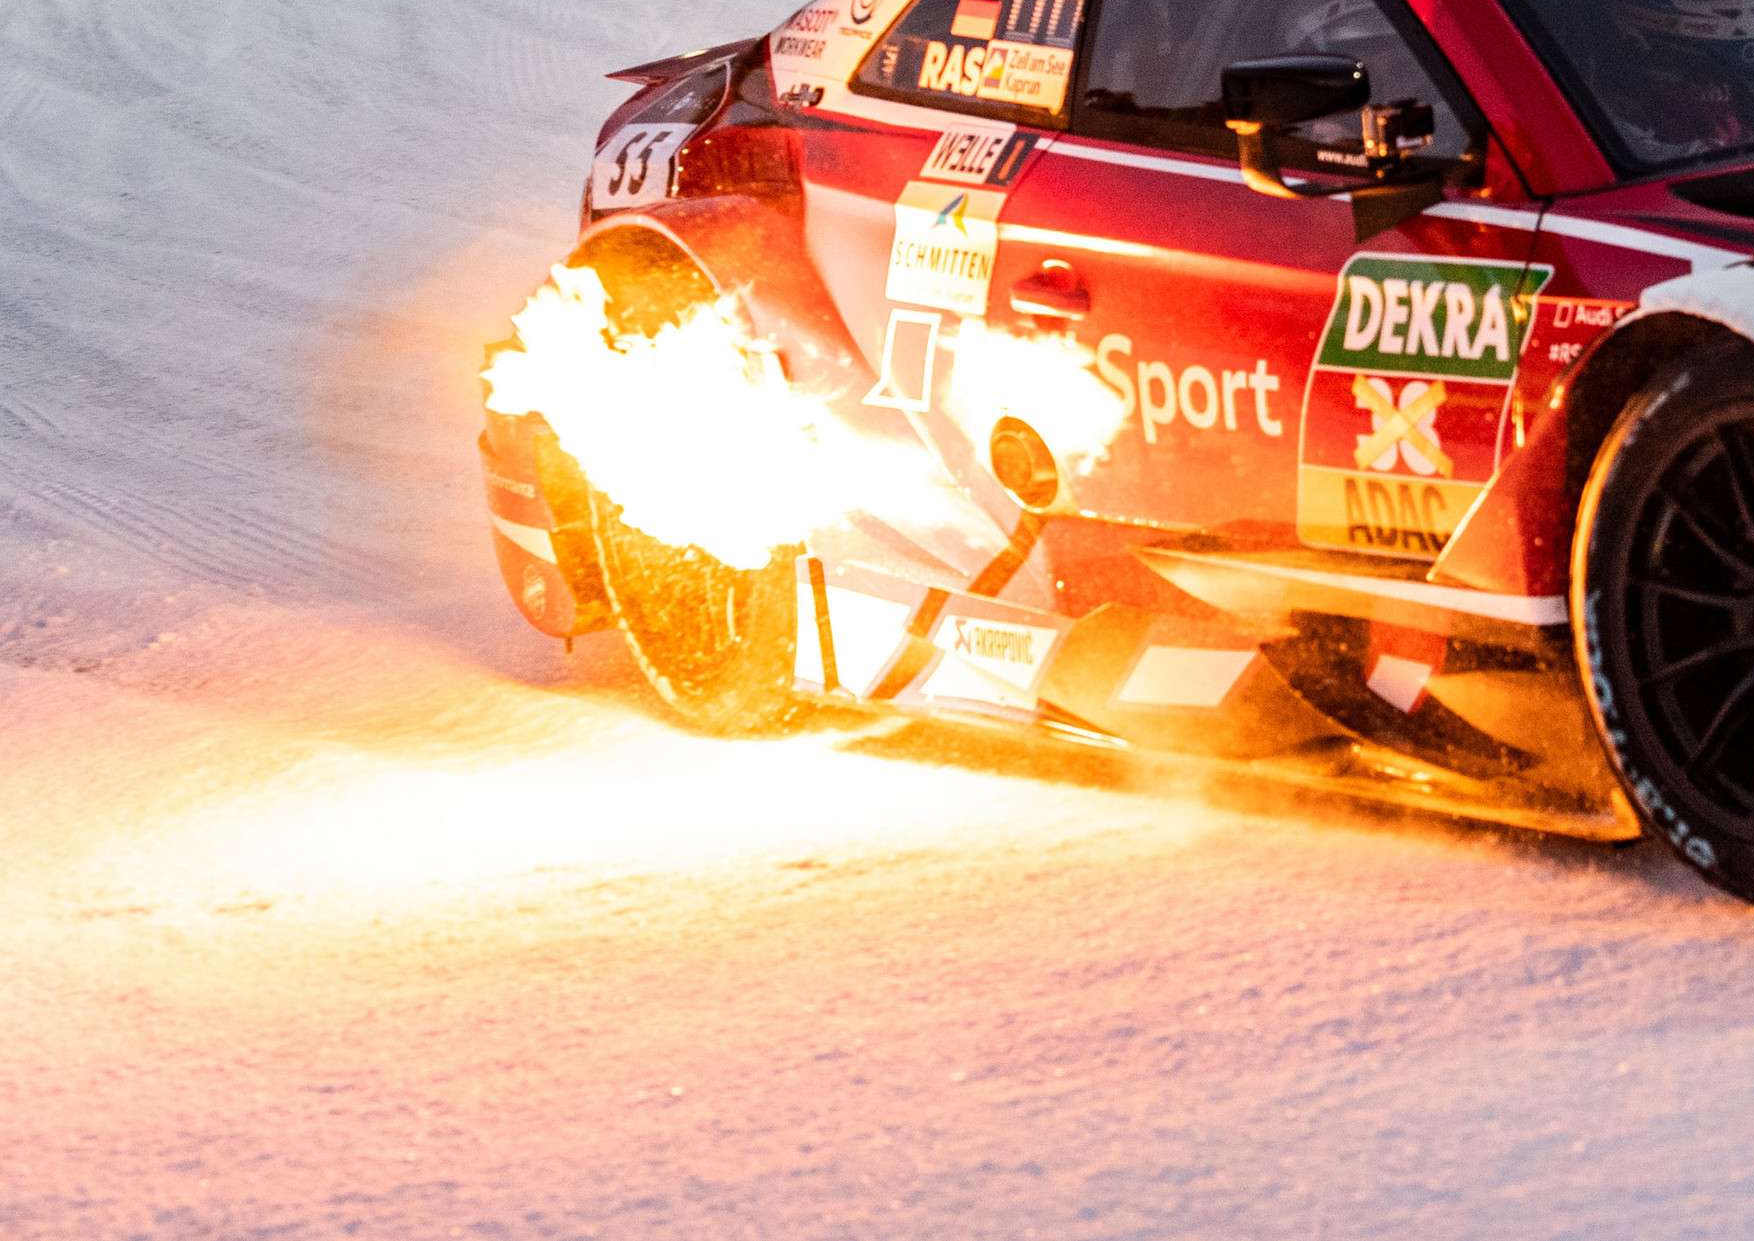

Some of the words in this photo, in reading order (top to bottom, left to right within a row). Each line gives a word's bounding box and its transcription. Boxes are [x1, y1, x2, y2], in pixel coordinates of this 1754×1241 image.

[1045, 54, 1066, 76] See
[894, 240, 991, 281] SCHMITTEN
[1343, 275, 1511, 362] DEKRA
[1097, 333, 1283, 445] Sport
[1345, 476, 1452, 552] ADAC
